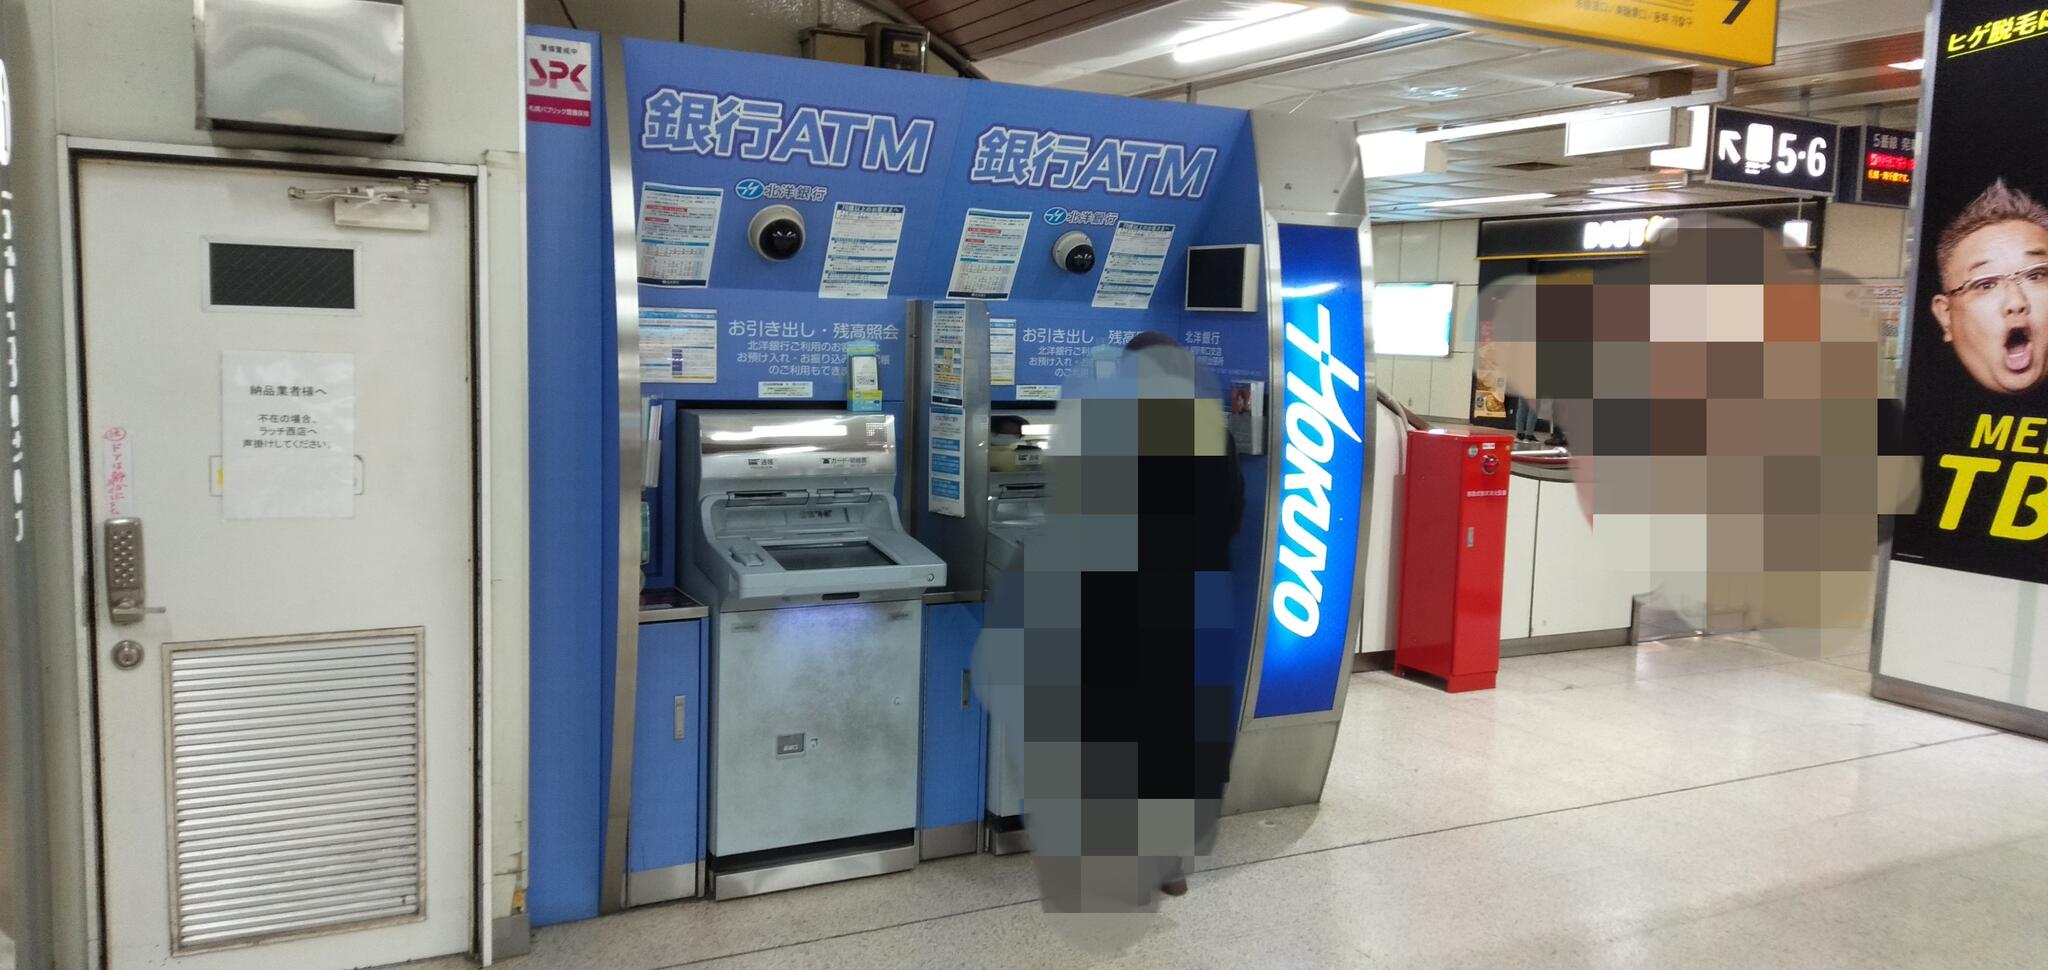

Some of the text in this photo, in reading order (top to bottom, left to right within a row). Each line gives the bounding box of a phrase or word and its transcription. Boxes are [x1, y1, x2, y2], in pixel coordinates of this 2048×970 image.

[528, 58, 588, 92] SPK
[763, 182, 828, 202] 北洋銀行
[1067, 210, 1119, 226] 北洋銀行
[728, 319, 900, 340] お引き出し・残高照会
[250, 385, 327, 397] 納品業者様へ
[259, 426, 317, 436] ラッチ西店へ
[1970, 413, 2048, 455] ME
